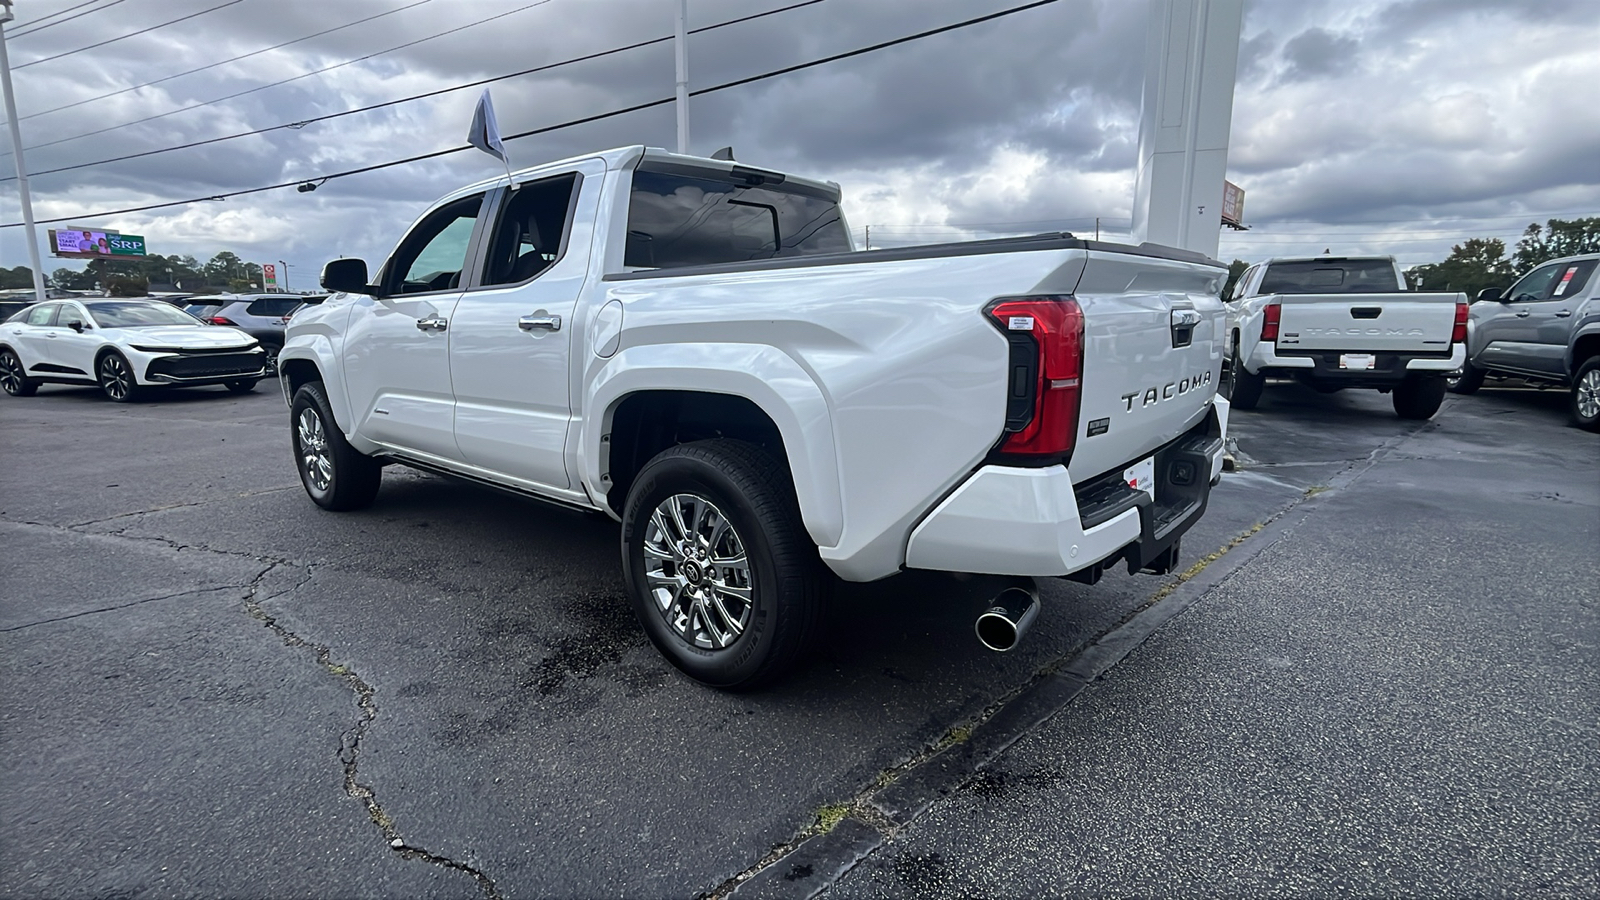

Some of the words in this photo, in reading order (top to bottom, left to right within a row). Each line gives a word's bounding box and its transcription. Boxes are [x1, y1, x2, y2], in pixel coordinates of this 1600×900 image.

[110, 240, 142, 249] SRP
[1306, 328, 1424, 336] TACOMA
[1121, 371, 1211, 413] TACOMA
